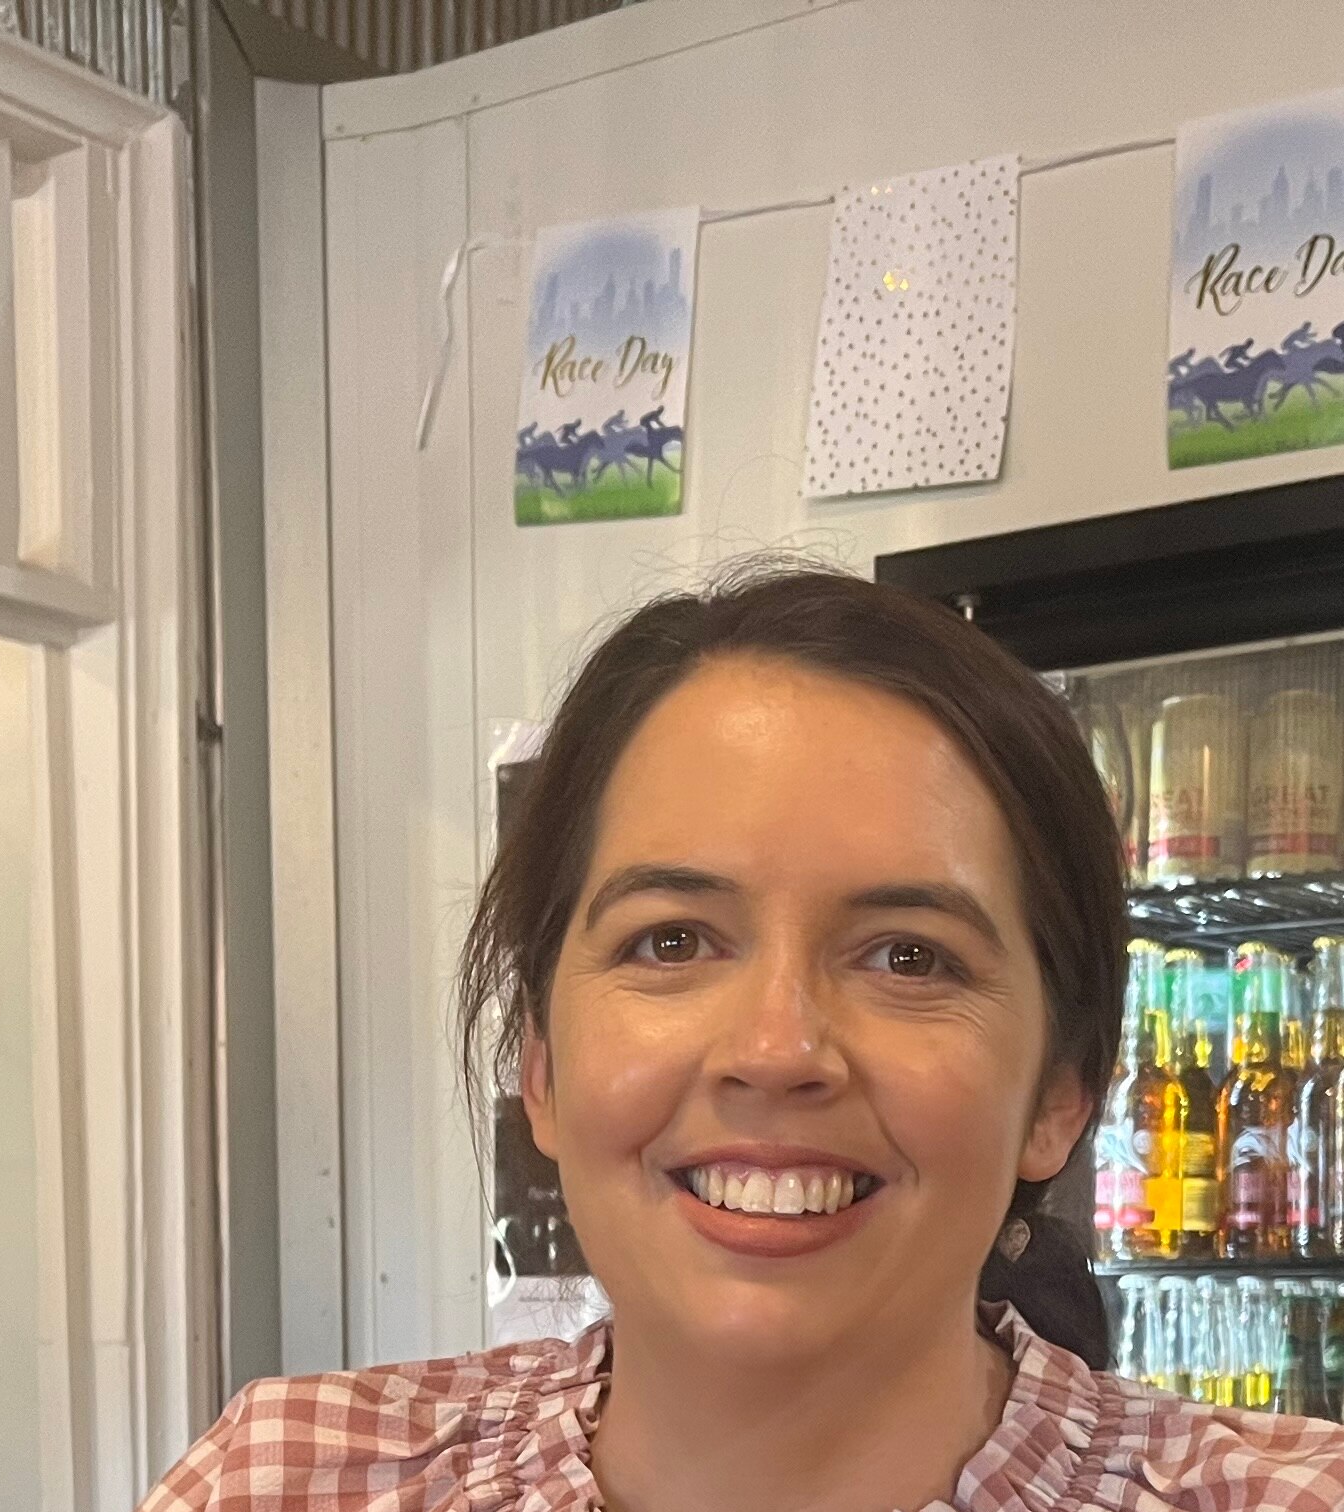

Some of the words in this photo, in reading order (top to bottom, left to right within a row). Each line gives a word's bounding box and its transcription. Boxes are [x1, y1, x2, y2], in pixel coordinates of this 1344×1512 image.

[1185, 242, 1287, 315] Race
[536, 336, 605, 397] Race
[614, 336, 682, 395] Day
